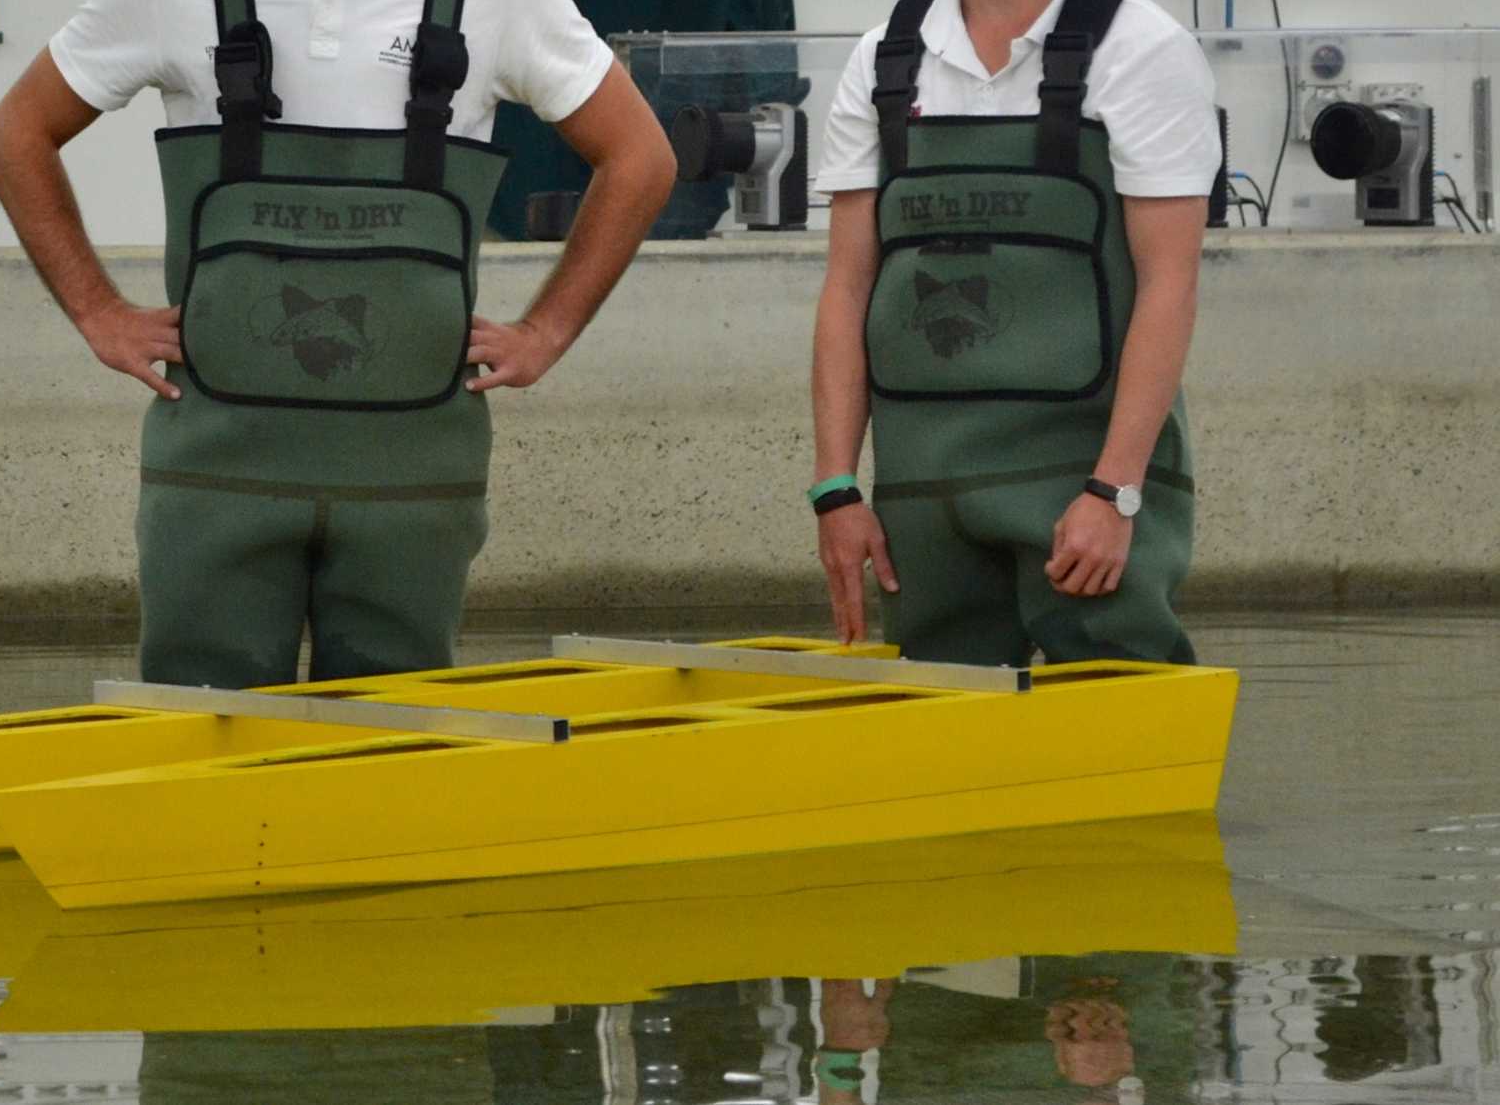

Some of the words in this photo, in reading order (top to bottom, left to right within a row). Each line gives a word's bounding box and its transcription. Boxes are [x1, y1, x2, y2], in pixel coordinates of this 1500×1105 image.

[390, 36, 418, 53] AM
[252, 202, 308, 230] FLY
[348, 203, 405, 230] DRY
[900, 194, 934, 222] FLY
[968, 191, 1032, 218] DRY
